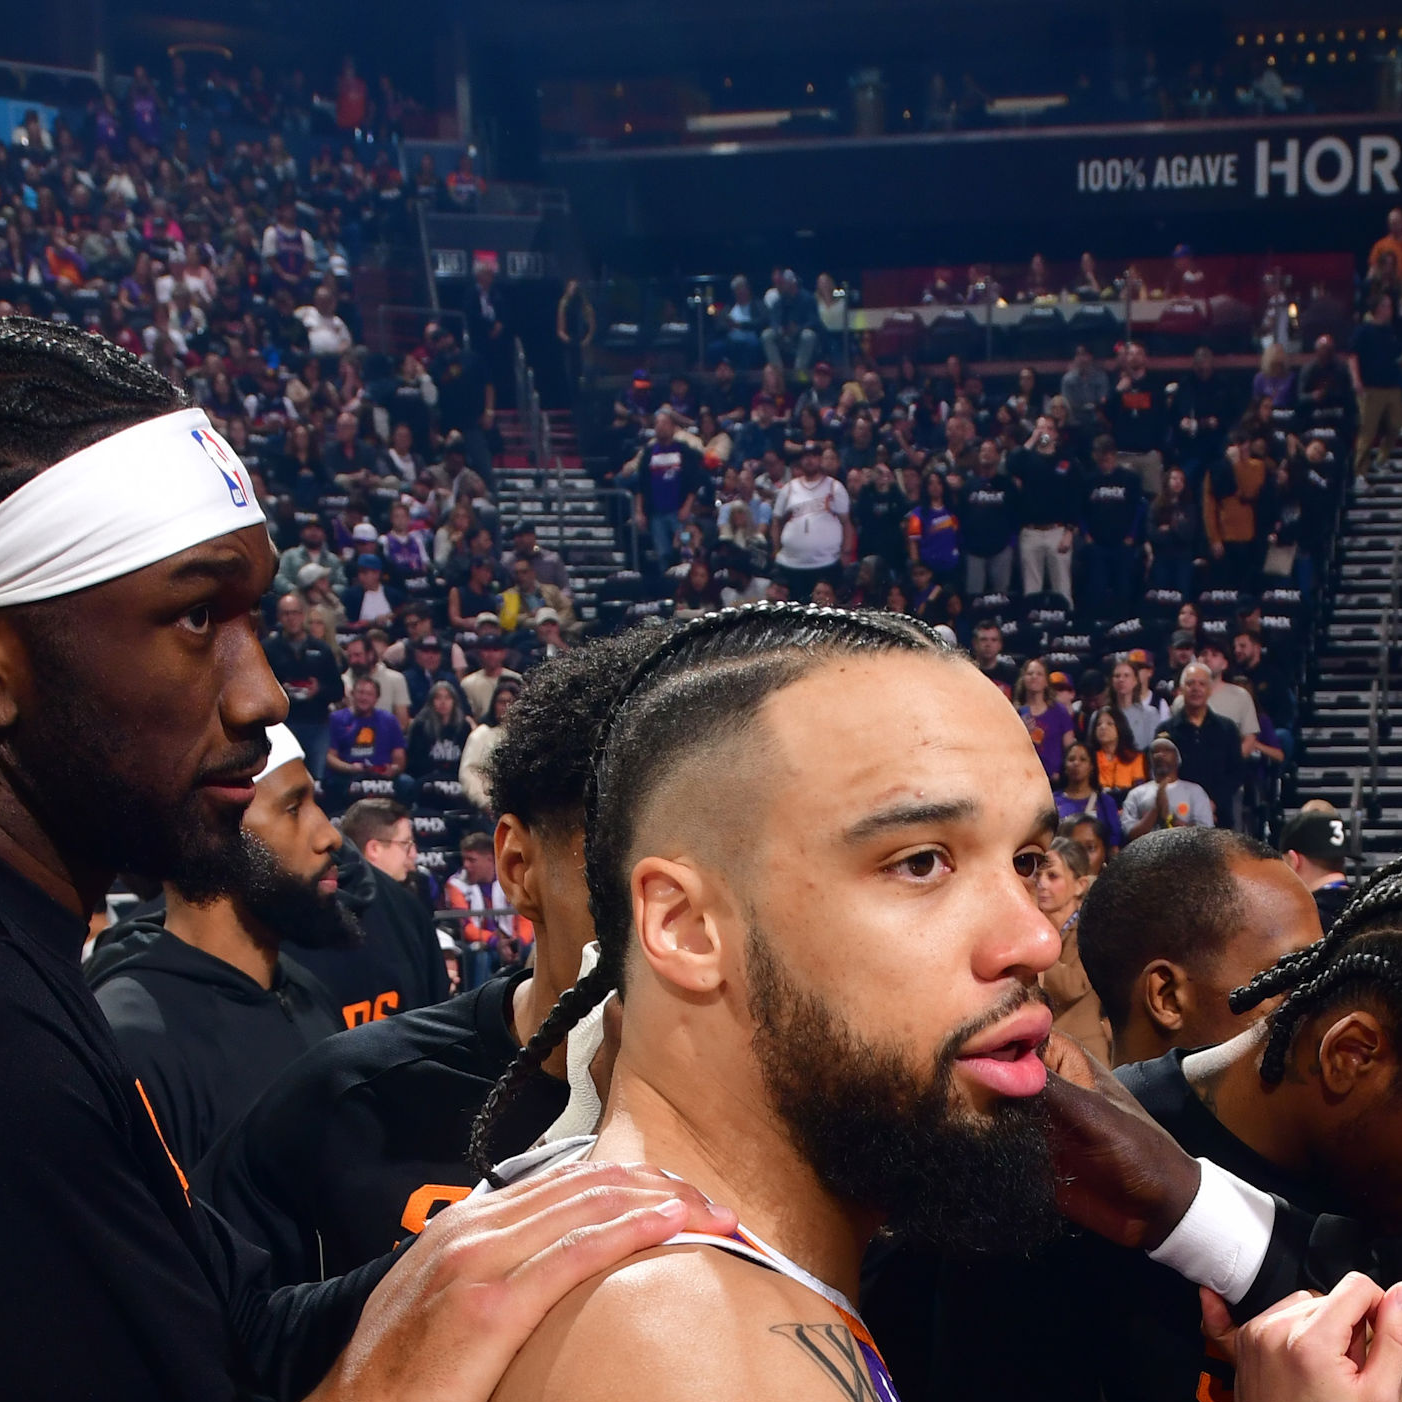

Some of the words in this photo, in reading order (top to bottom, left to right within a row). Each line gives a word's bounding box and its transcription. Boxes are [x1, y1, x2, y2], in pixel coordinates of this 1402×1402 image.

[1078, 157, 1147, 194] 100%
[1153, 153, 1238, 189] AGAVE
[361, 780, 395, 793] PHX
[1329, 820, 1345, 847] 3
